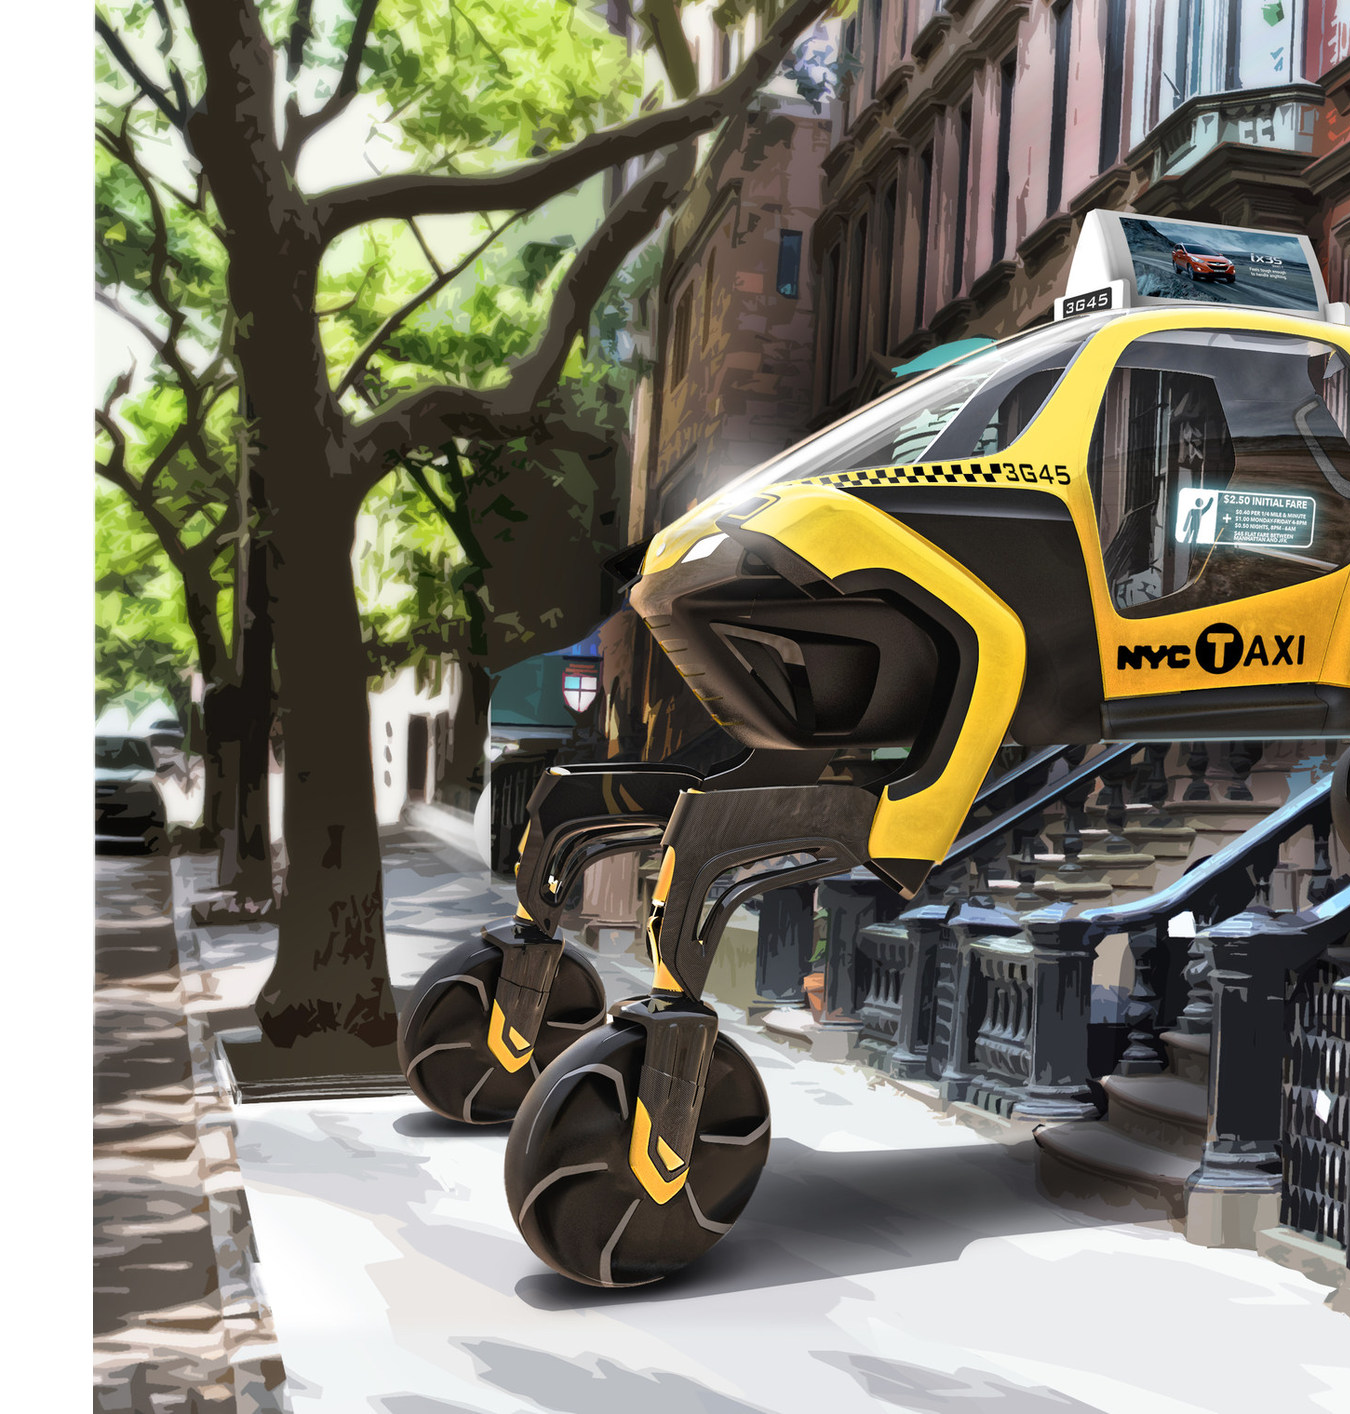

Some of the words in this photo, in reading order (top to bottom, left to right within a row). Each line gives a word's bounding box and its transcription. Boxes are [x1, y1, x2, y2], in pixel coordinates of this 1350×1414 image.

[1066, 293, 1108, 314] 3G45
[1002, 463, 1071, 485] 3G45
[1224, 494, 1250, 504] $2.50
[1252, 497, 1284, 507] INITIAL
[1285, 500, 1308, 509] FARE
[1117, 645, 1191, 670] NYC
[1204, 631, 1305, 669] TAXI
